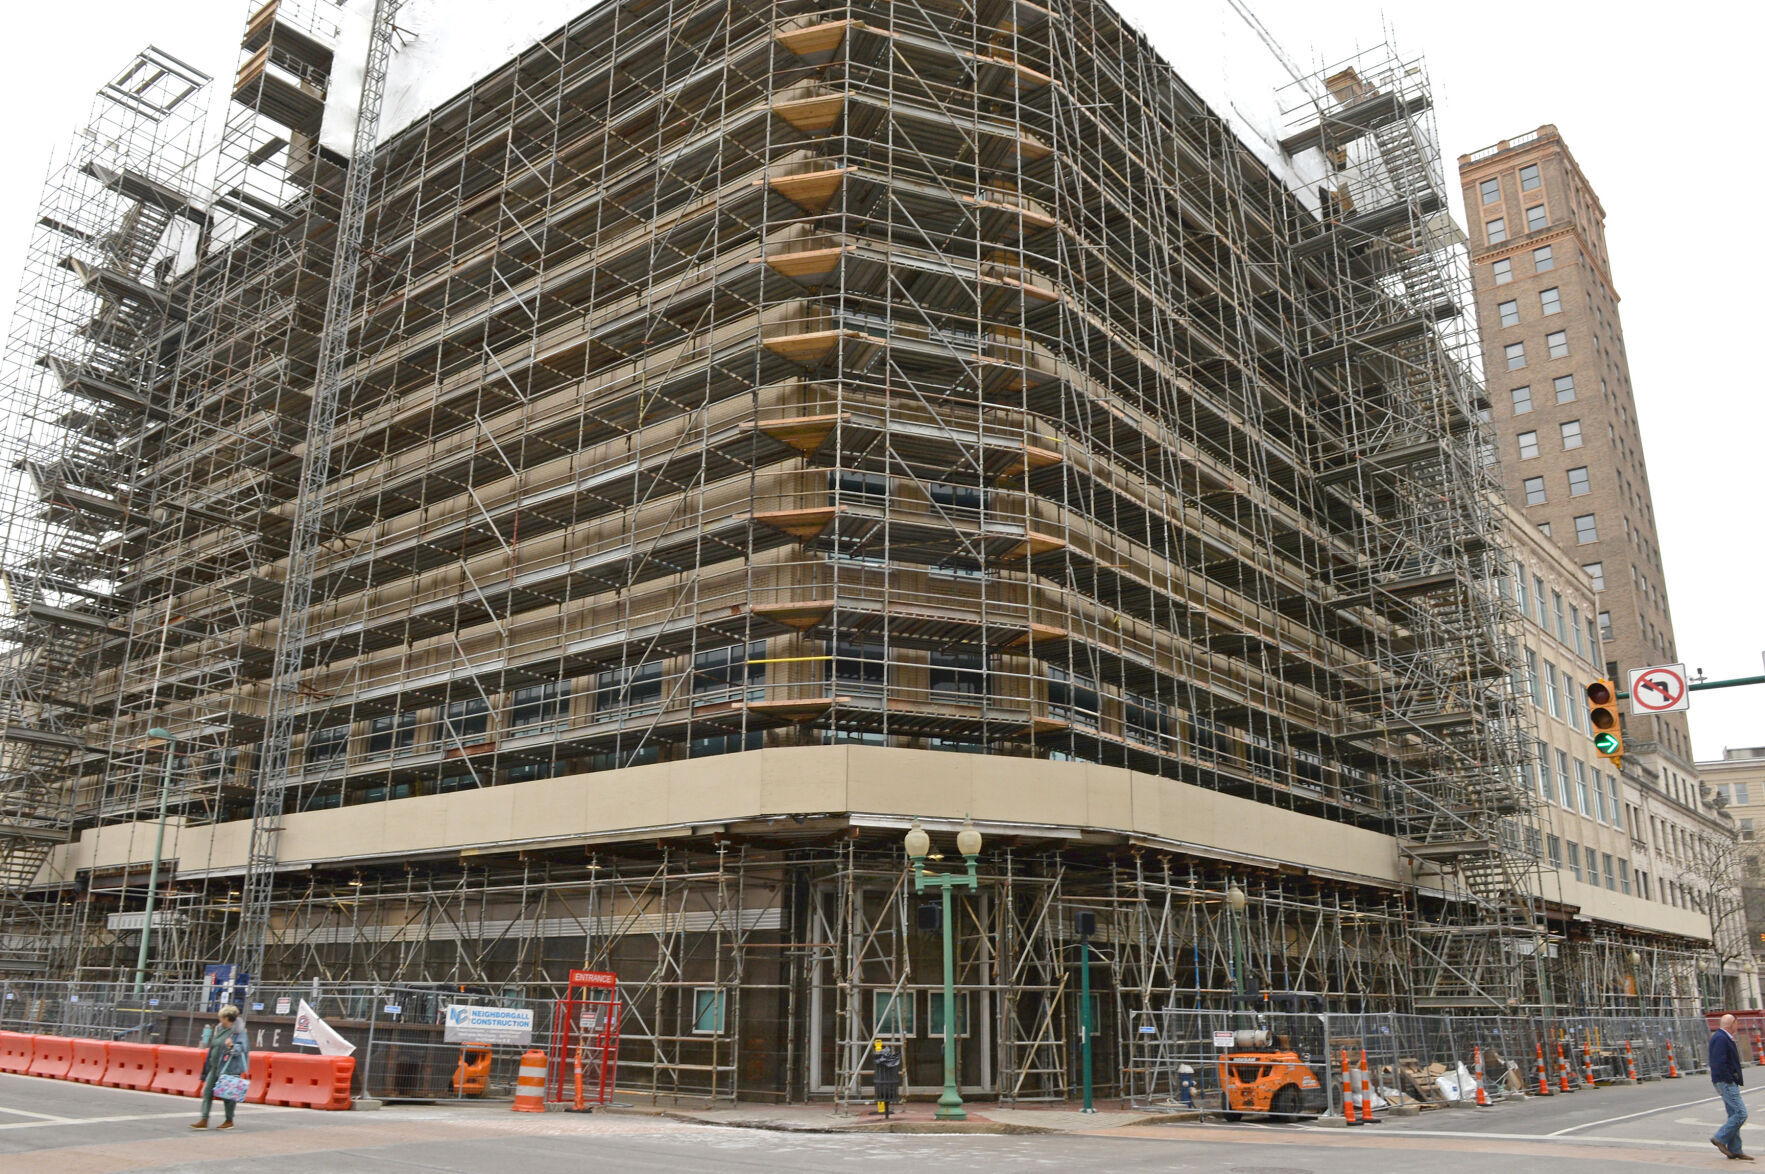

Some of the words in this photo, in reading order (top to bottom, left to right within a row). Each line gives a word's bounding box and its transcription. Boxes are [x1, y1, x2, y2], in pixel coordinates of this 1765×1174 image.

[575, 972, 612, 984] ENTRANCE
[472, 1010, 529, 1020] NEIGHBORGALL
[471, 1019, 530, 1028] CONSTRUCTION
